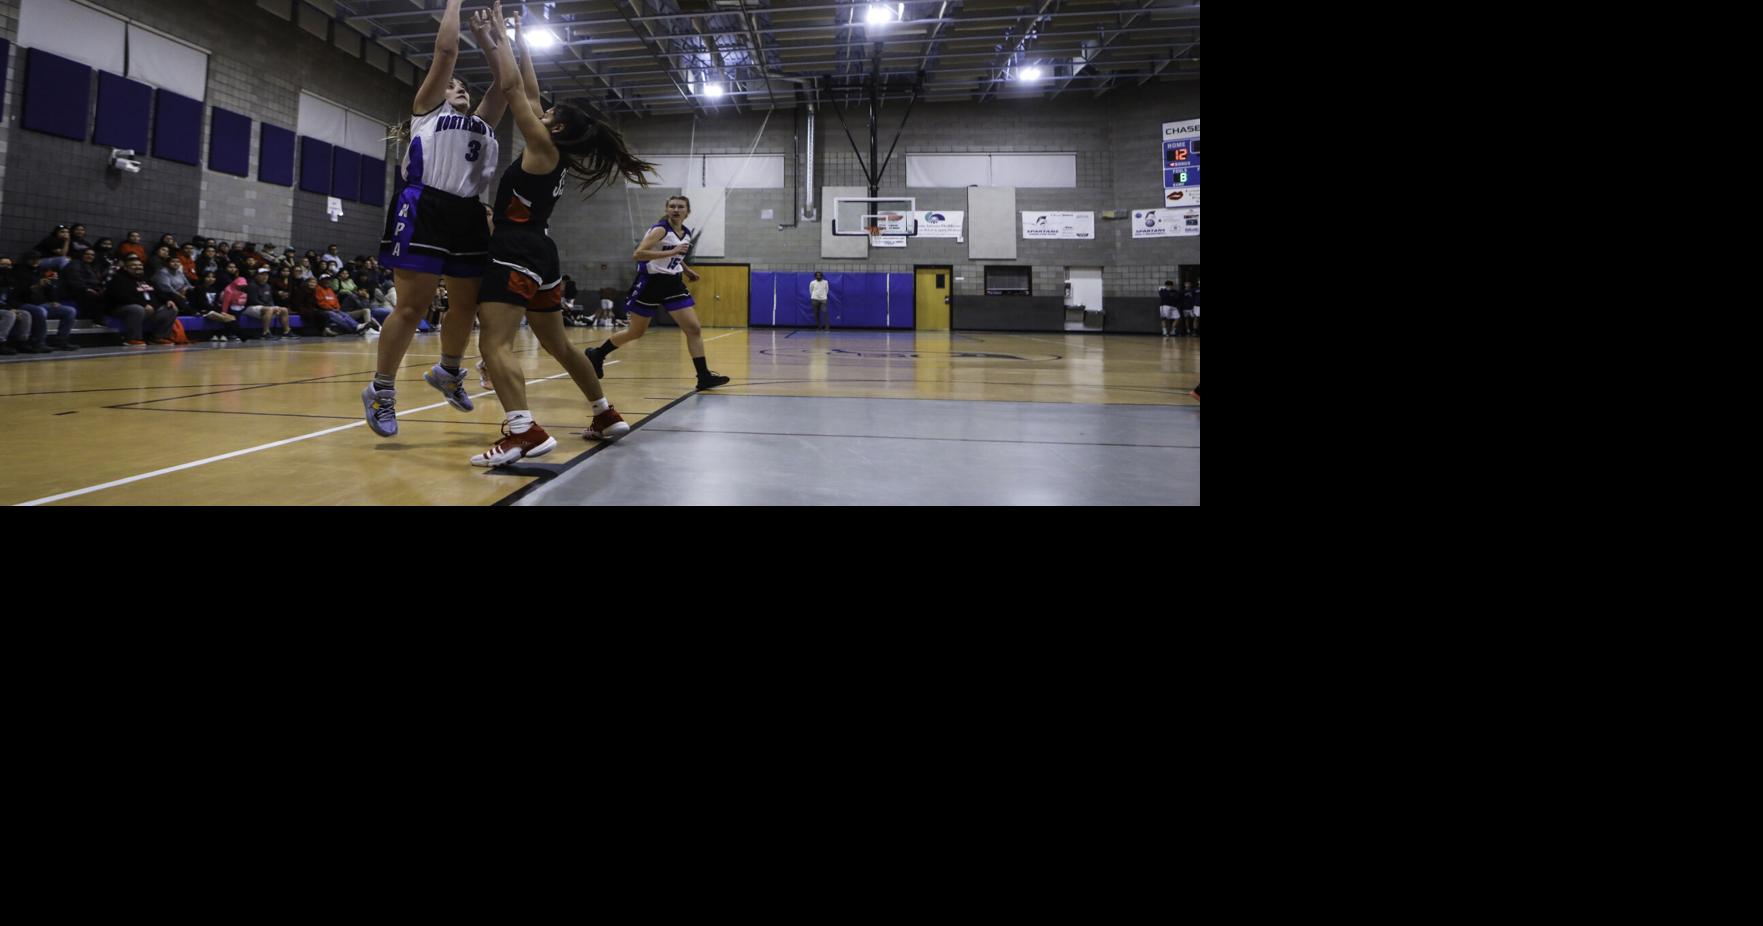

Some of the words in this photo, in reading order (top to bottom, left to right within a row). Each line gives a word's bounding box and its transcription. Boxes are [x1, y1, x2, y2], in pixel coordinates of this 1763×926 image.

[465, 140, 481, 162] 3
[1167, 141, 1186, 149] HOME
[1175, 148, 1187, 160] 12
[1180, 172, 1187, 182] 8
[667, 257, 681, 270] 15
